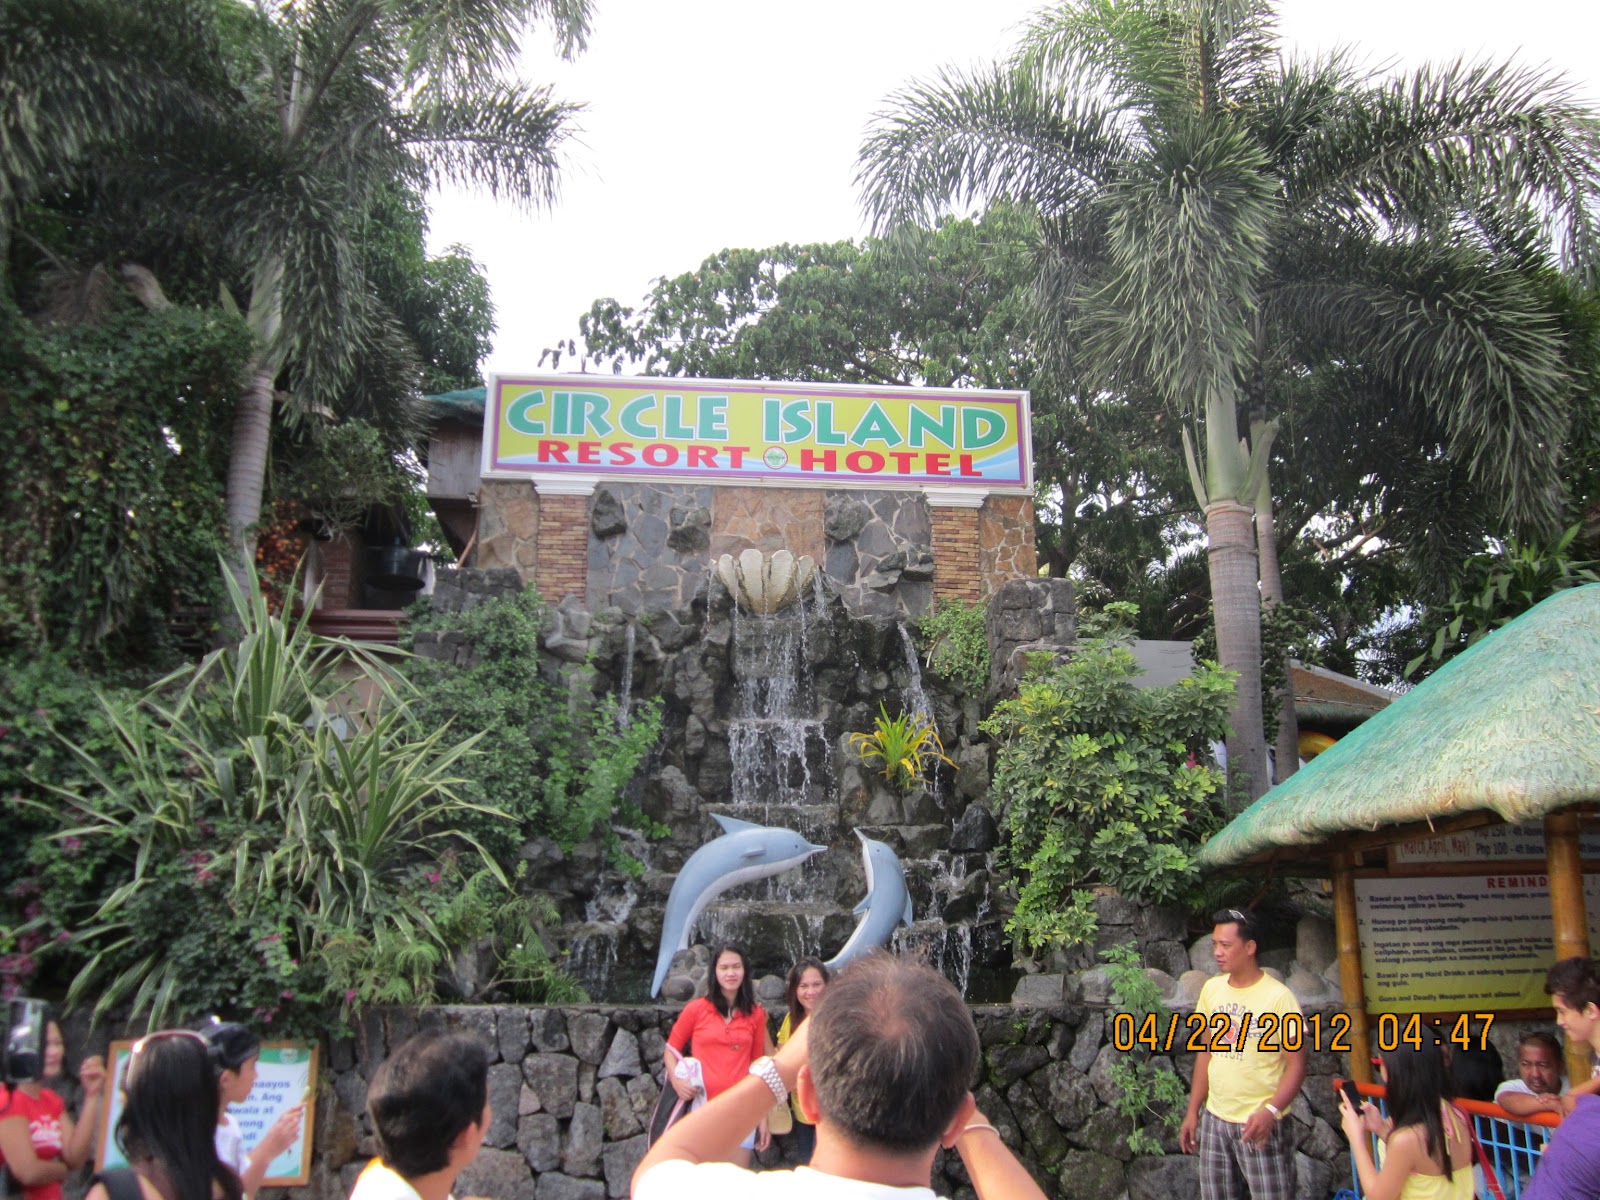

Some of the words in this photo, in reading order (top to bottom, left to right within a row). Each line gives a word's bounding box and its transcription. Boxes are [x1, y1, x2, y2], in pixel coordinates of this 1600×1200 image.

[505, 389, 729, 441] CIRCLE
[762, 397, 1008, 451] ISLAND
[537, 440, 751, 469] RESORT
[800, 449, 983, 477] HOTEL
[1413, 994, 1437, 1002] Deadly
